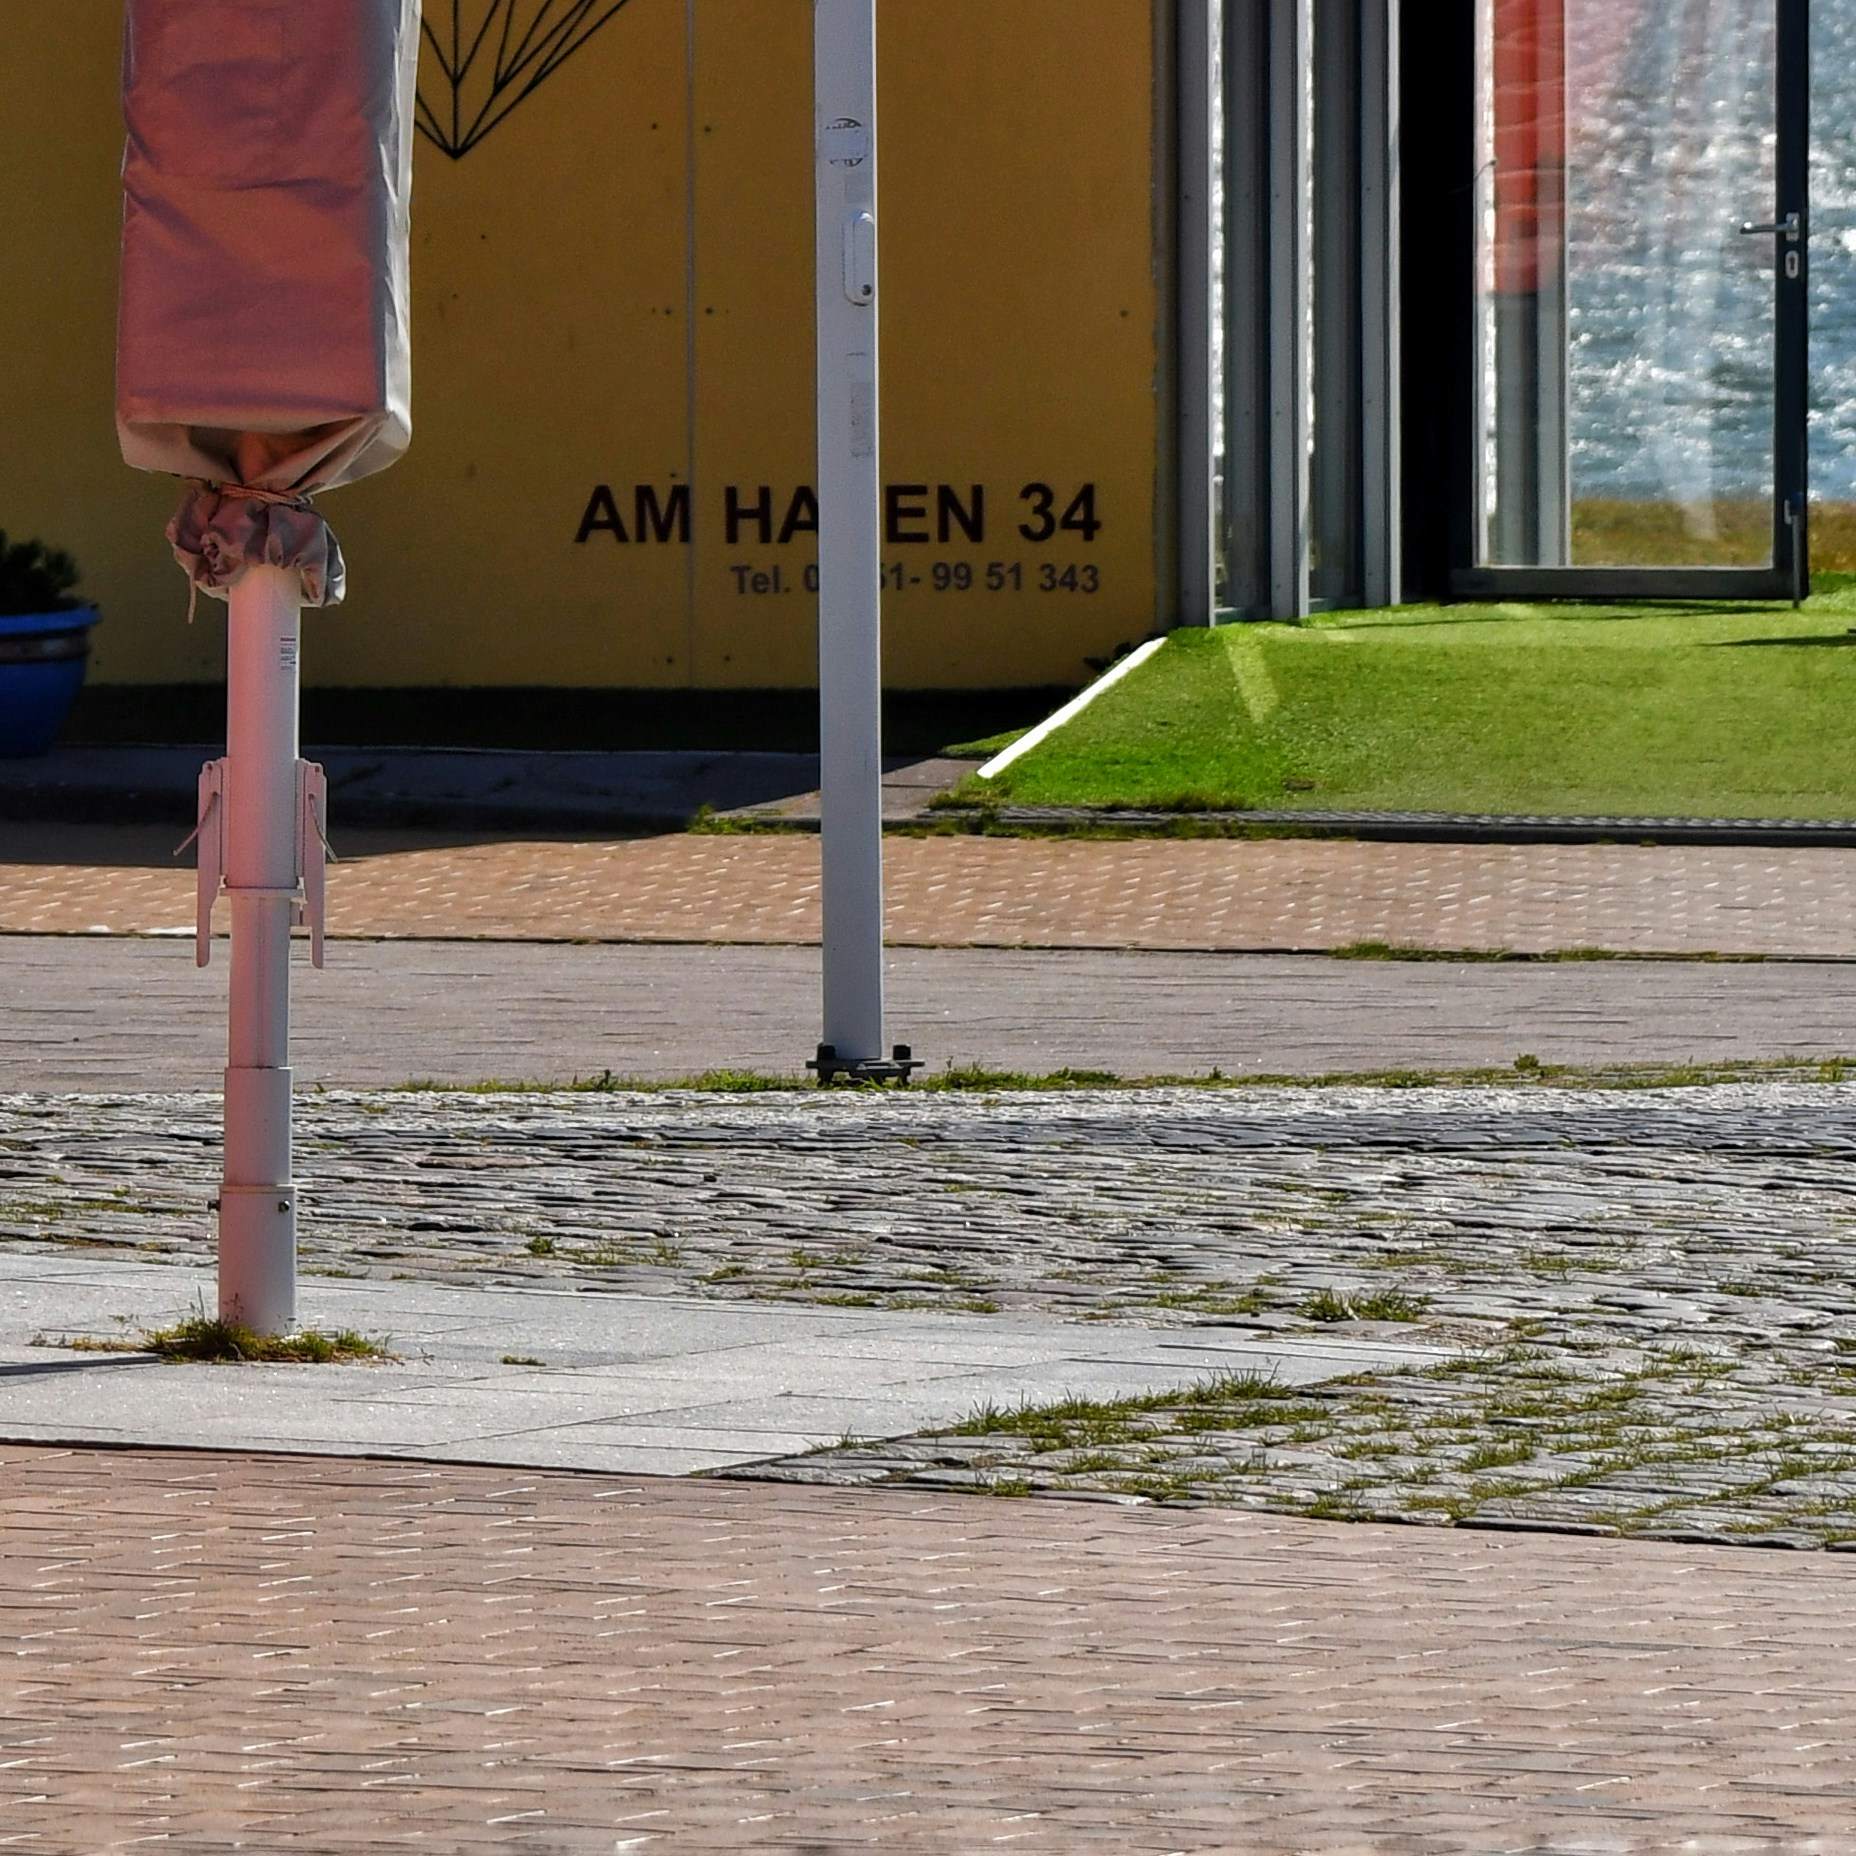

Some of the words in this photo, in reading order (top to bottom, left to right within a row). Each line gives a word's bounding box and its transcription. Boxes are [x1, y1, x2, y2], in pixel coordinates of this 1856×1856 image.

[574, 485, 693, 543] AM
[723, 484, 986, 544] HAEN
[1018, 483, 1102, 543] 34
[731, 564, 791, 595] Tel.
[932, 562, 973, 590] 99
[986, 562, 1023, 590] 51
[1039, 563, 1100, 593] 343
